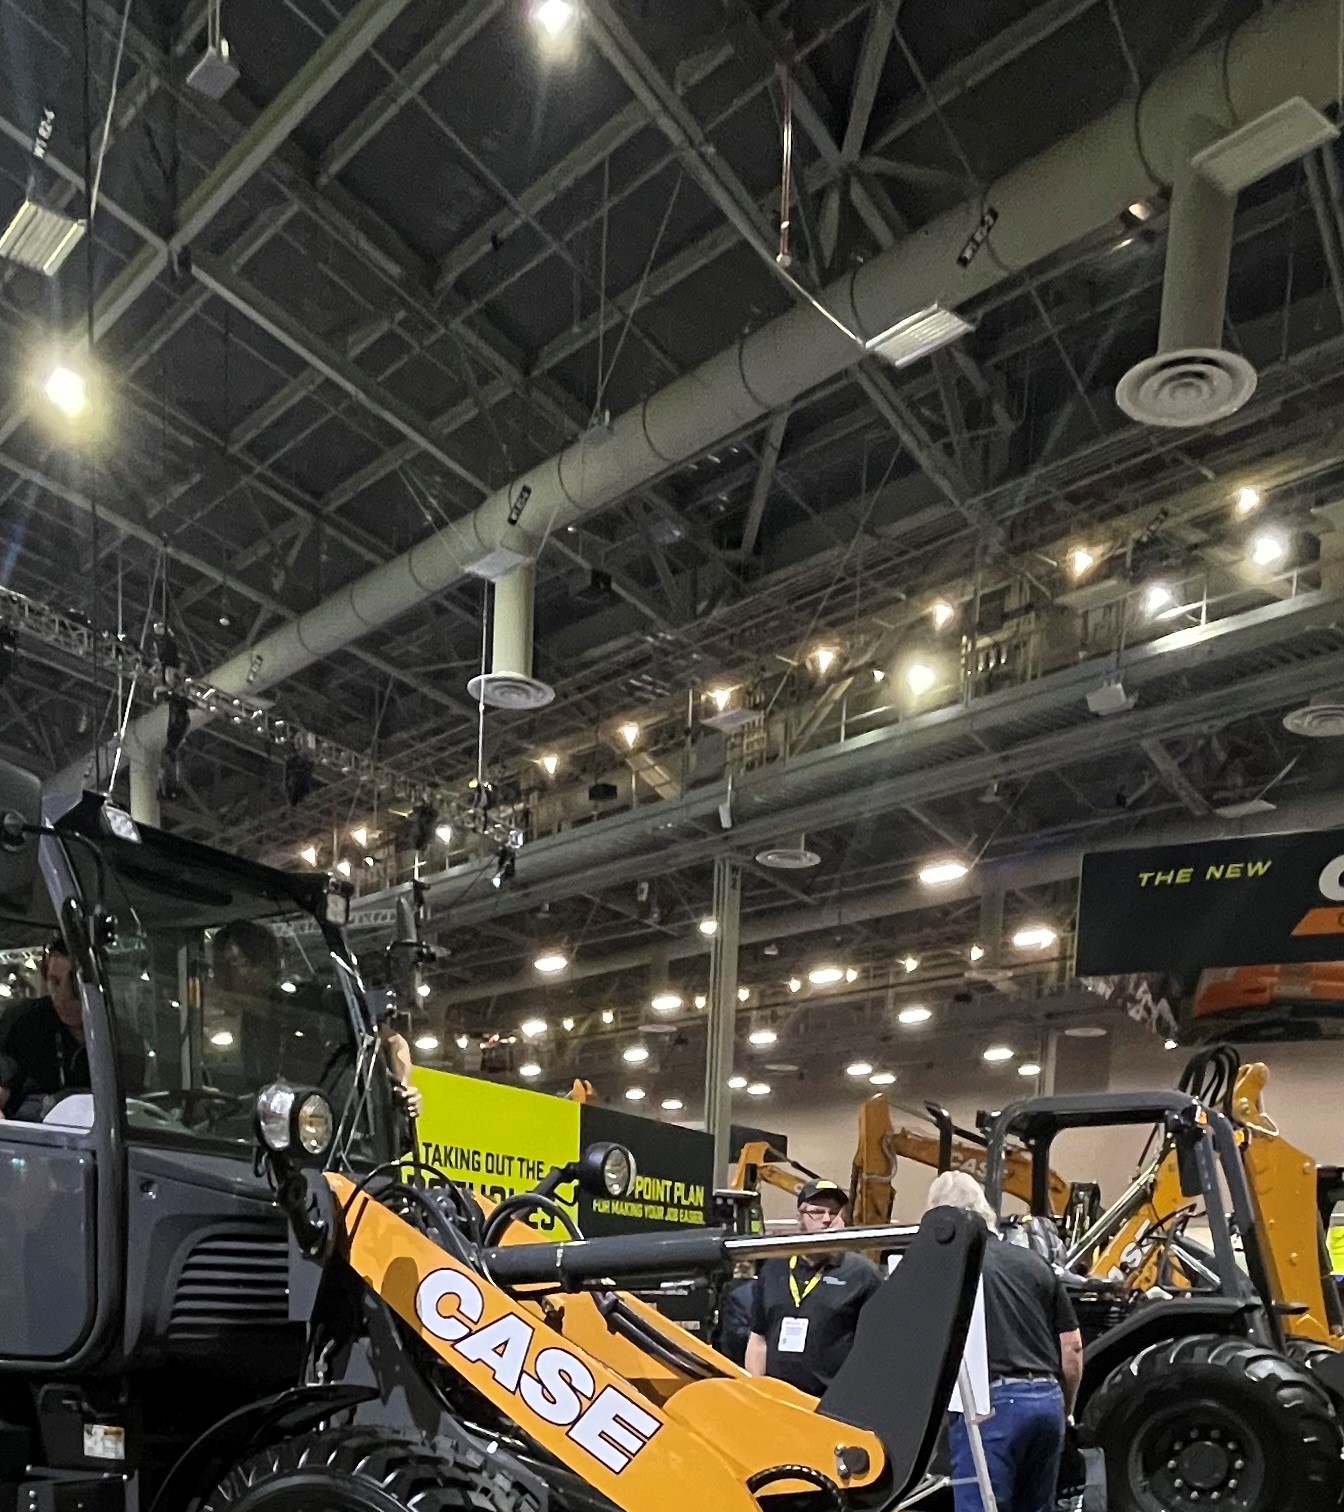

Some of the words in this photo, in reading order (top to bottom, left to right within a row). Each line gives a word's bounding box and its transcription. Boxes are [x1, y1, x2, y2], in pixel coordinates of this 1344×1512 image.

[1139, 867, 1193, 888] THE
[1205, 860, 1272, 881] NEW
[422, 1142, 481, 1172] TAKING
[485, 1152, 514, 1177] OUT
[517, 1157, 544, 1181] THE
[635, 1175, 672, 1203] POINT
[674, 1181, 704, 1207] PLAN
[414, 1267, 664, 1475] CASE
